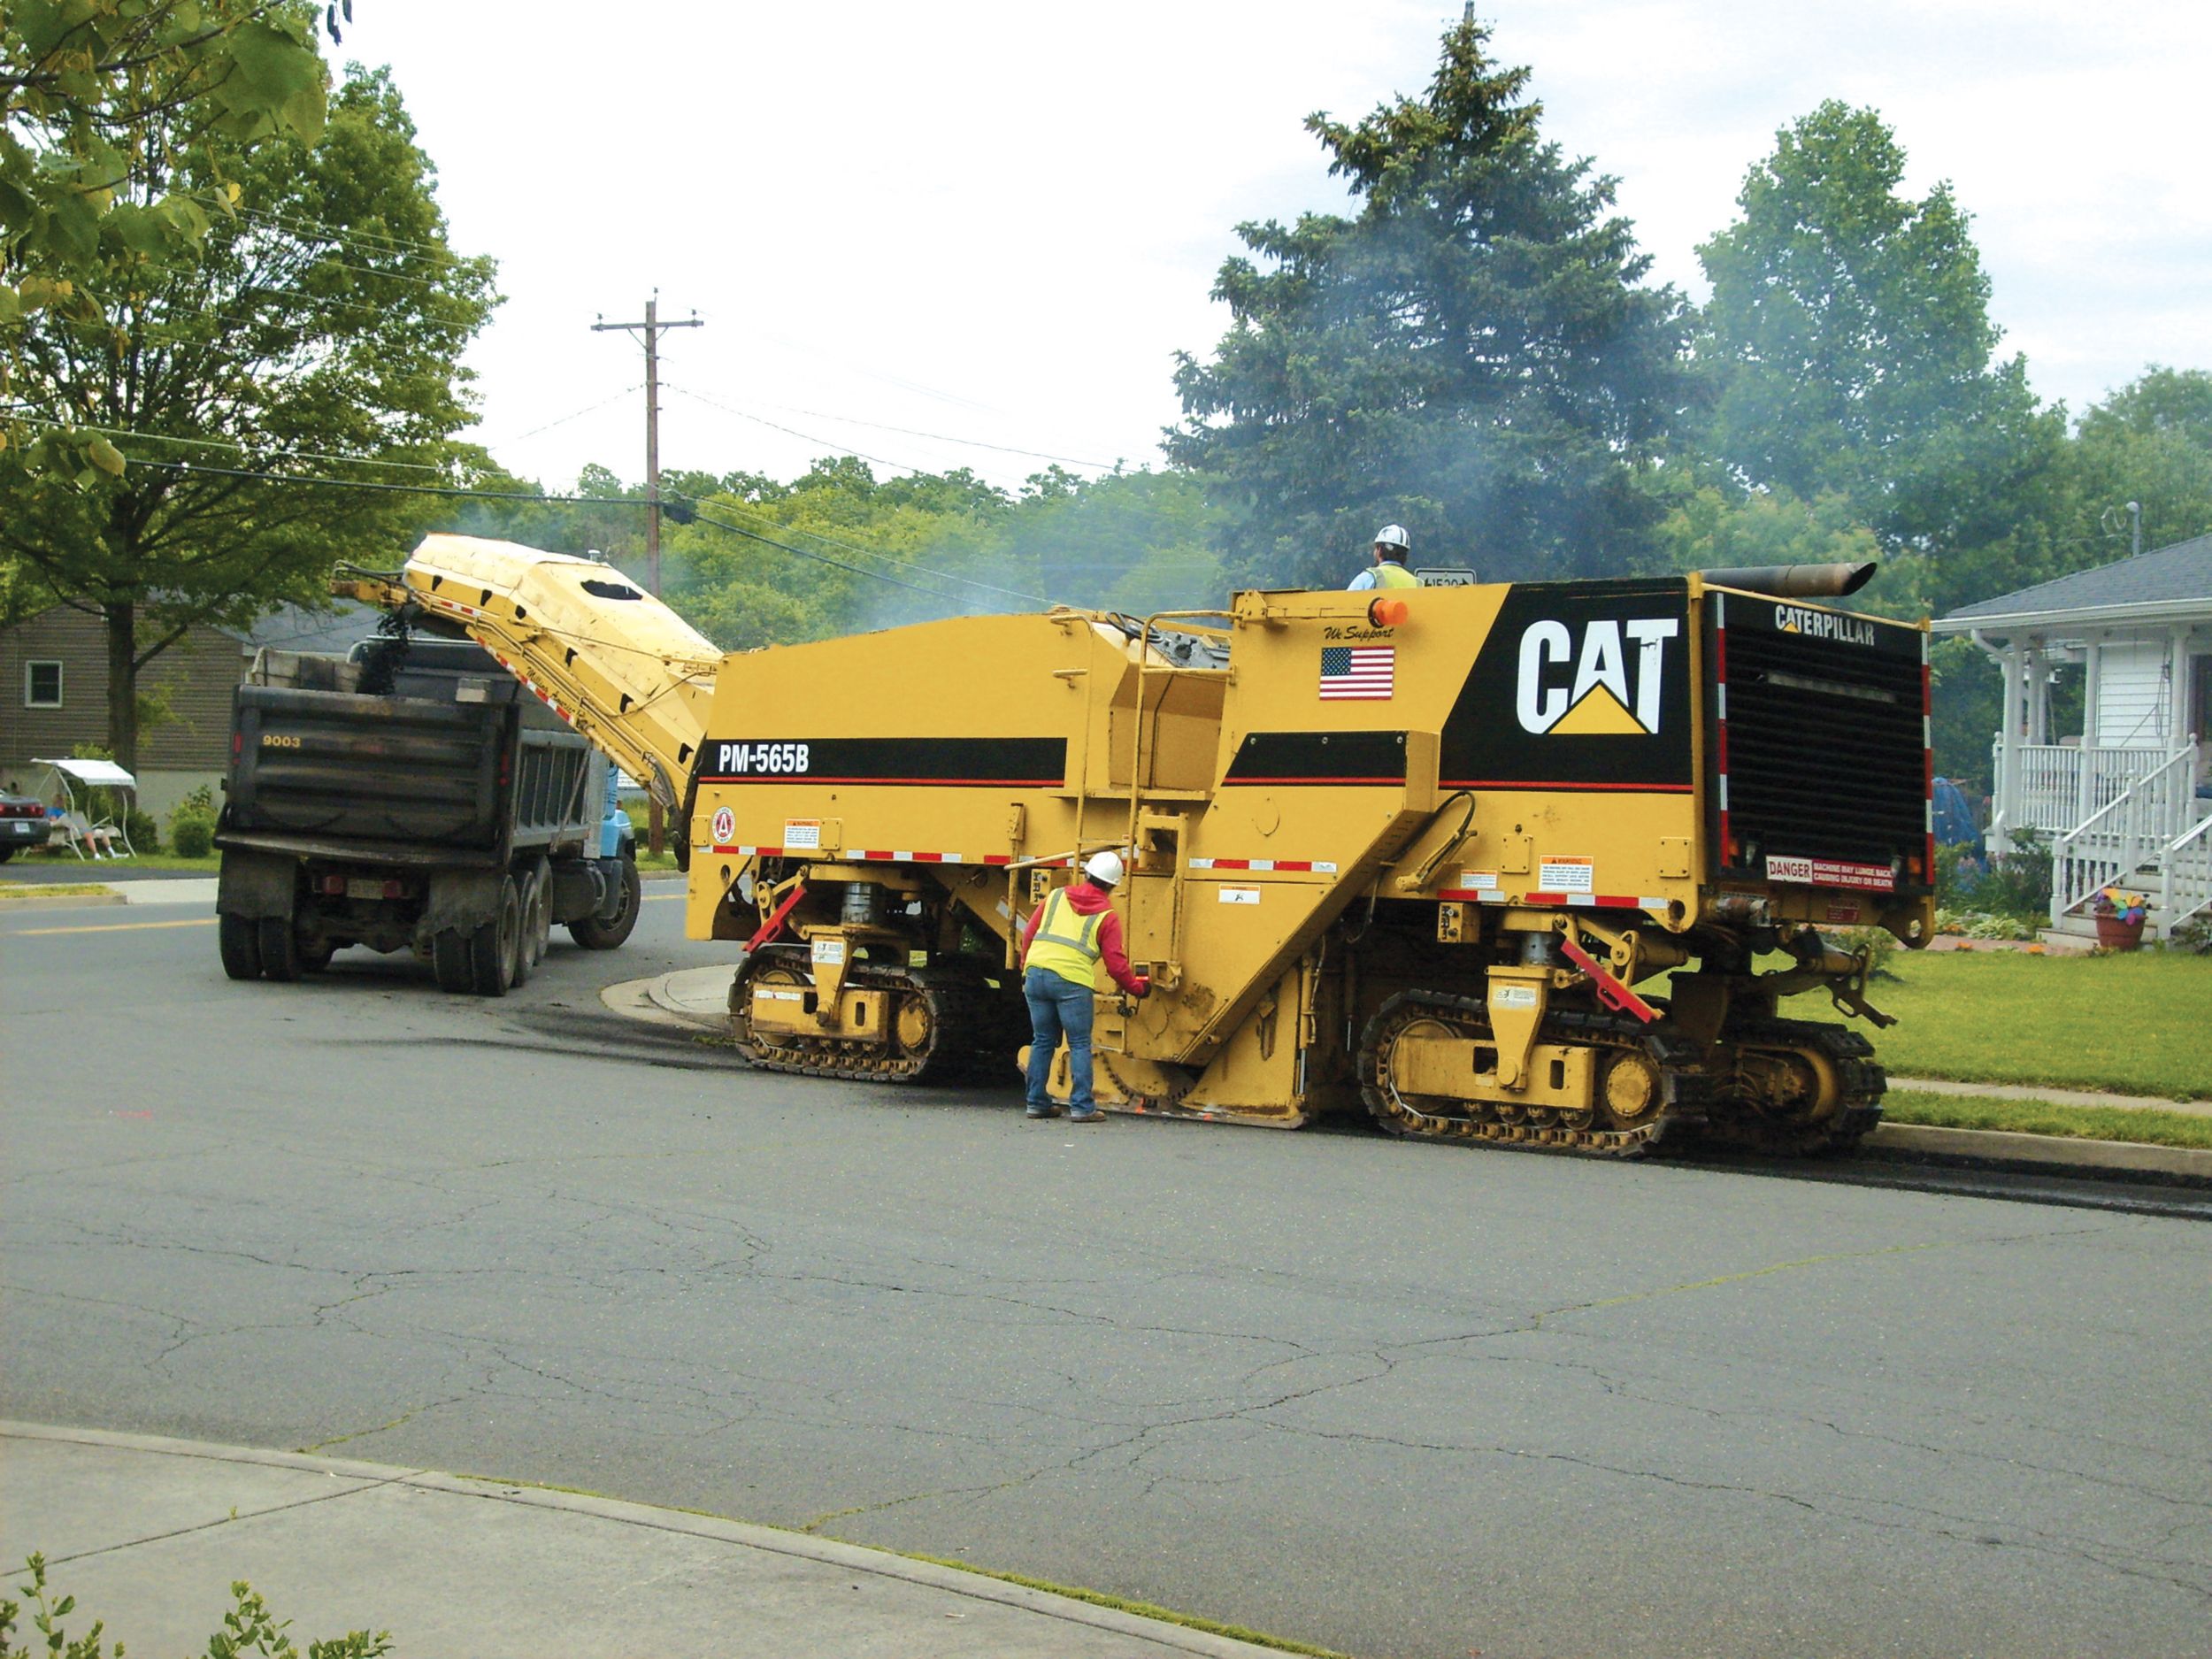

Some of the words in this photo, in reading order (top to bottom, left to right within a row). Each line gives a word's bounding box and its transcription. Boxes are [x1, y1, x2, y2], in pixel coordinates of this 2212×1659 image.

[1324, 626, 1343, 640] We
[1344, 626, 1394, 641] Support
[1775, 604, 1875, 646] CATERPILLAR
[1516, 618, 1678, 734] CAT
[263, 734, 302, 749] 9003
[718, 743, 810, 773] PM-565B
[1769, 860, 1810, 879] DANGER
[1813, 862, 1840, 872] MACHINE
[1841, 864, 1855, 874] MAY
